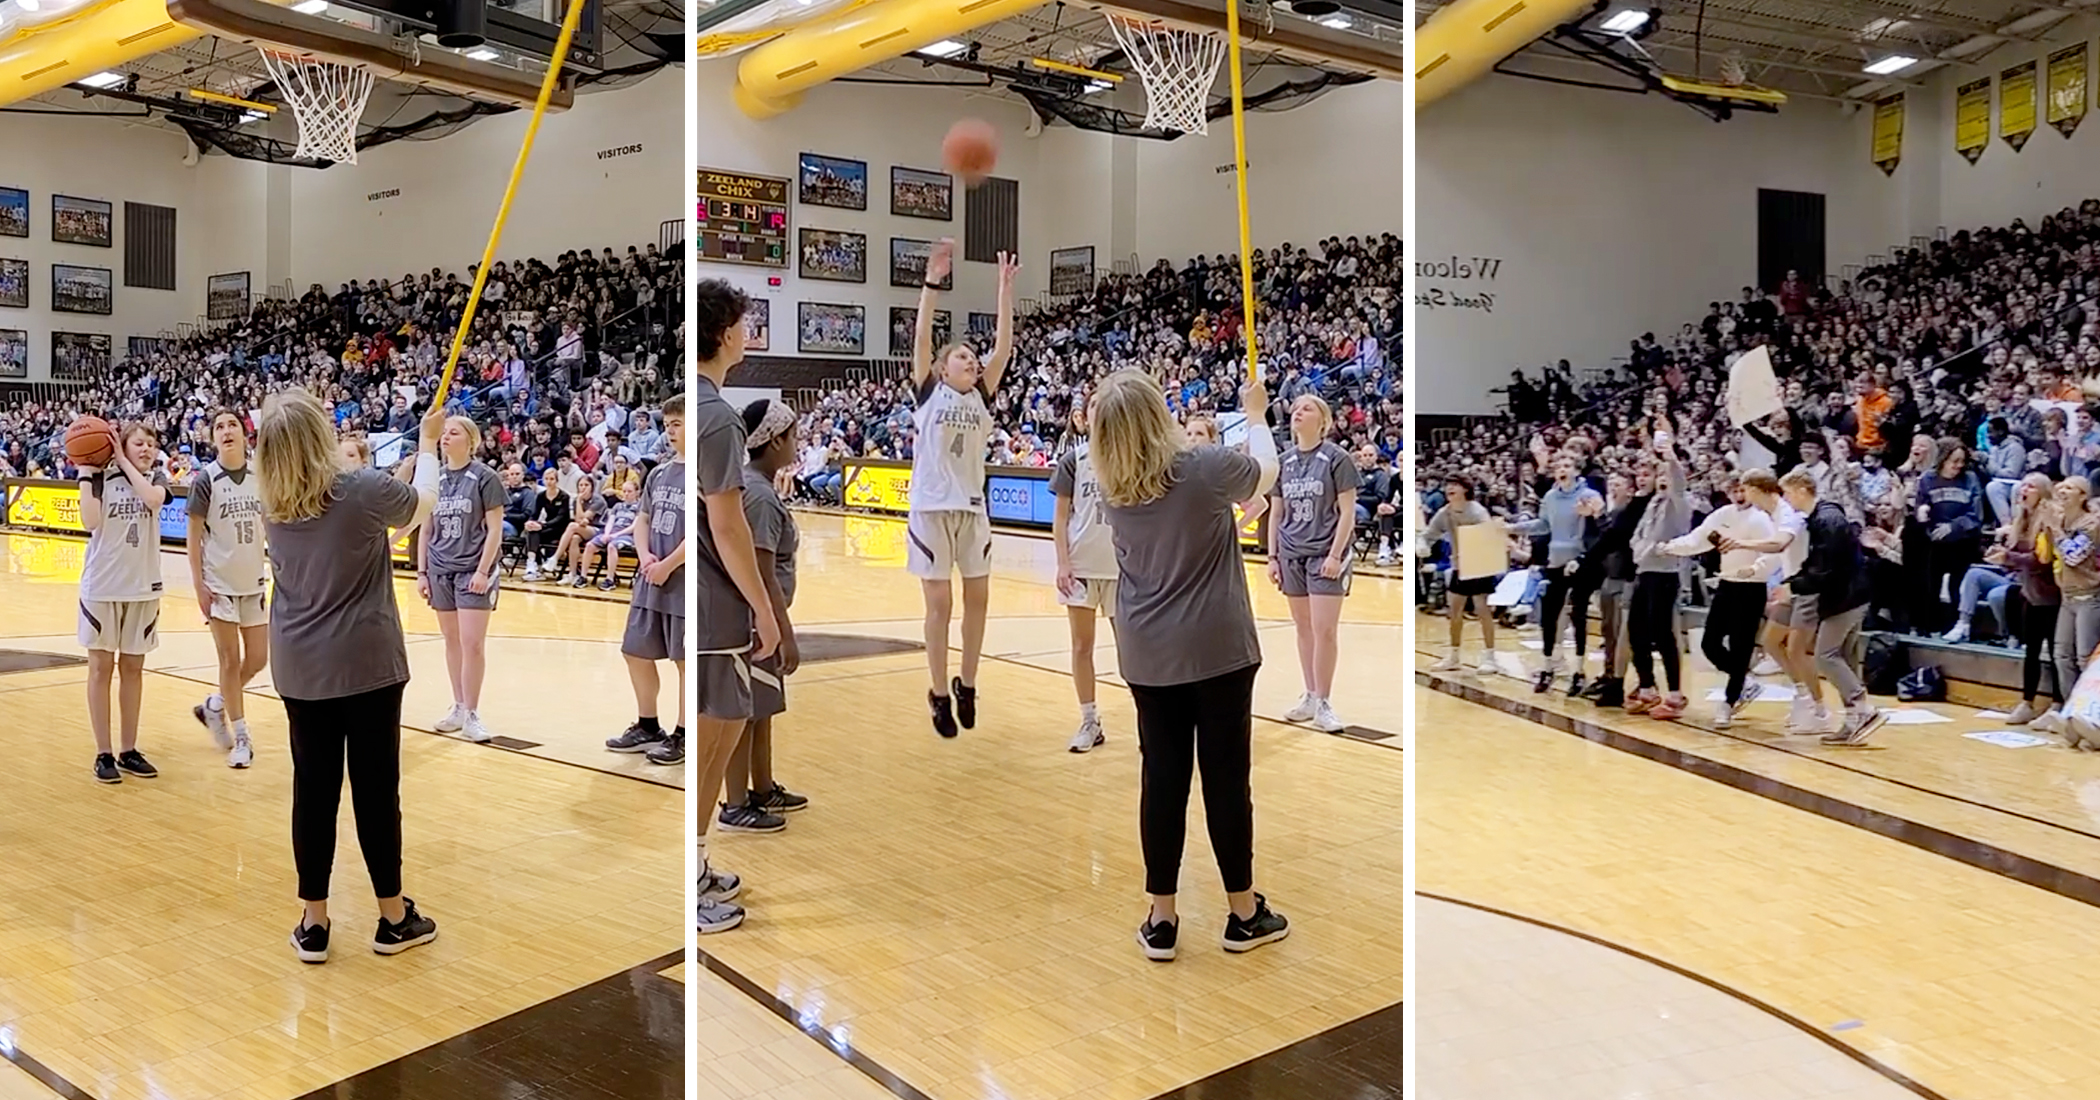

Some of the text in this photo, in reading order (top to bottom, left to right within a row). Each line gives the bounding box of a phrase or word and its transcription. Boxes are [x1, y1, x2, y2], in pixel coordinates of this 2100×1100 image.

[597, 143, 643, 160] VISITORS
[707, 173, 764, 189] ZEELAND
[717, 184, 753, 198] CHIX
[367, 188, 400, 201] VISITORS
[935, 408, 980, 430] ZEELAN
[949, 432, 965, 459] 4
[108, 501, 153, 519] ZEELAN
[1290, 499, 1314, 522] 33
[234, 520, 255, 545] 15
[440, 516, 462, 539] 33
[651, 509, 678, 536] 40
[126, 523, 139, 548] 4
